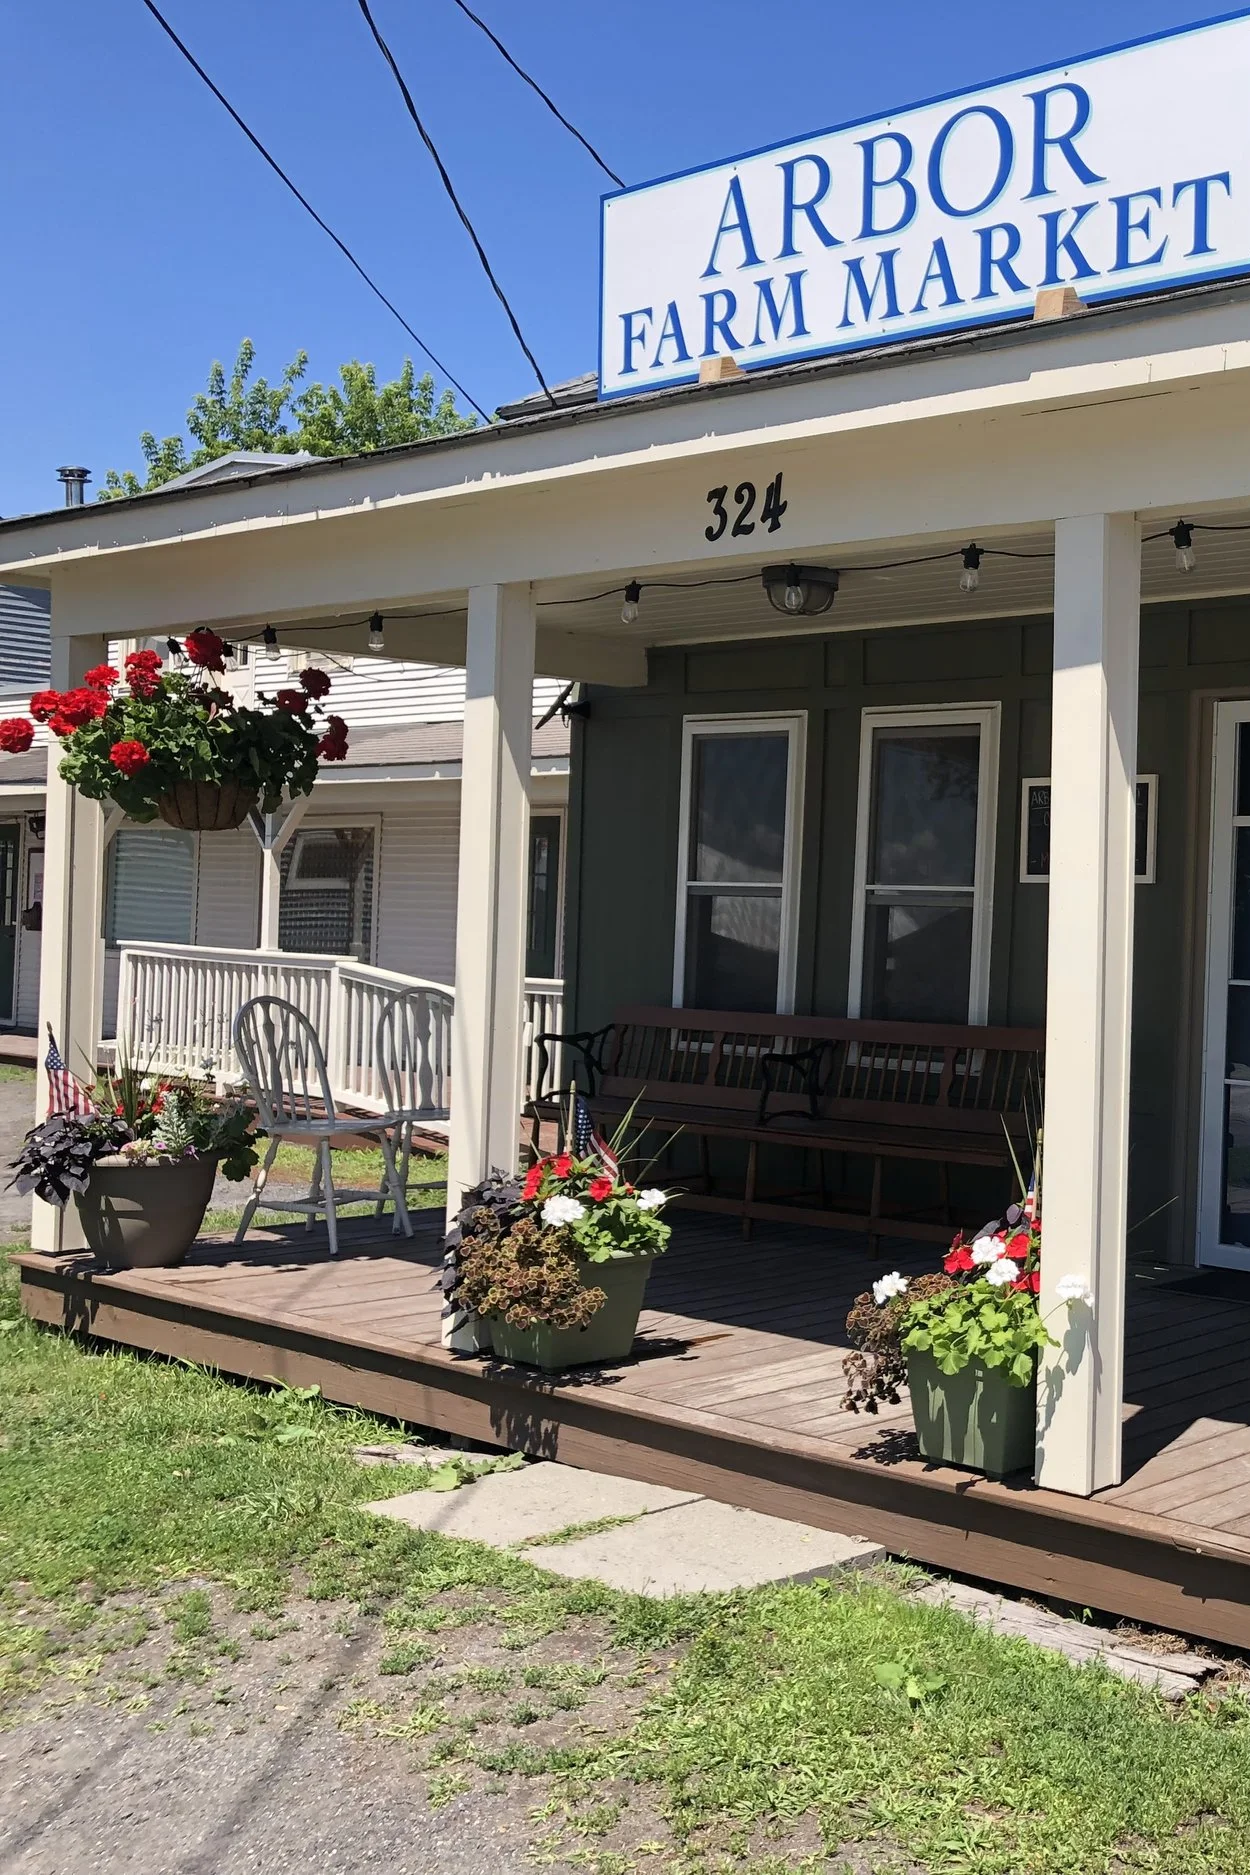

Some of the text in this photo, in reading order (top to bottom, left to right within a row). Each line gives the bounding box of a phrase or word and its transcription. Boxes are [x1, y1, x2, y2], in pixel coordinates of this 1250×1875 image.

[617, 171, 1231, 376] FARM MARKET
[701, 82, 1107, 279] ARBOR
[704, 471, 788, 542] 324
